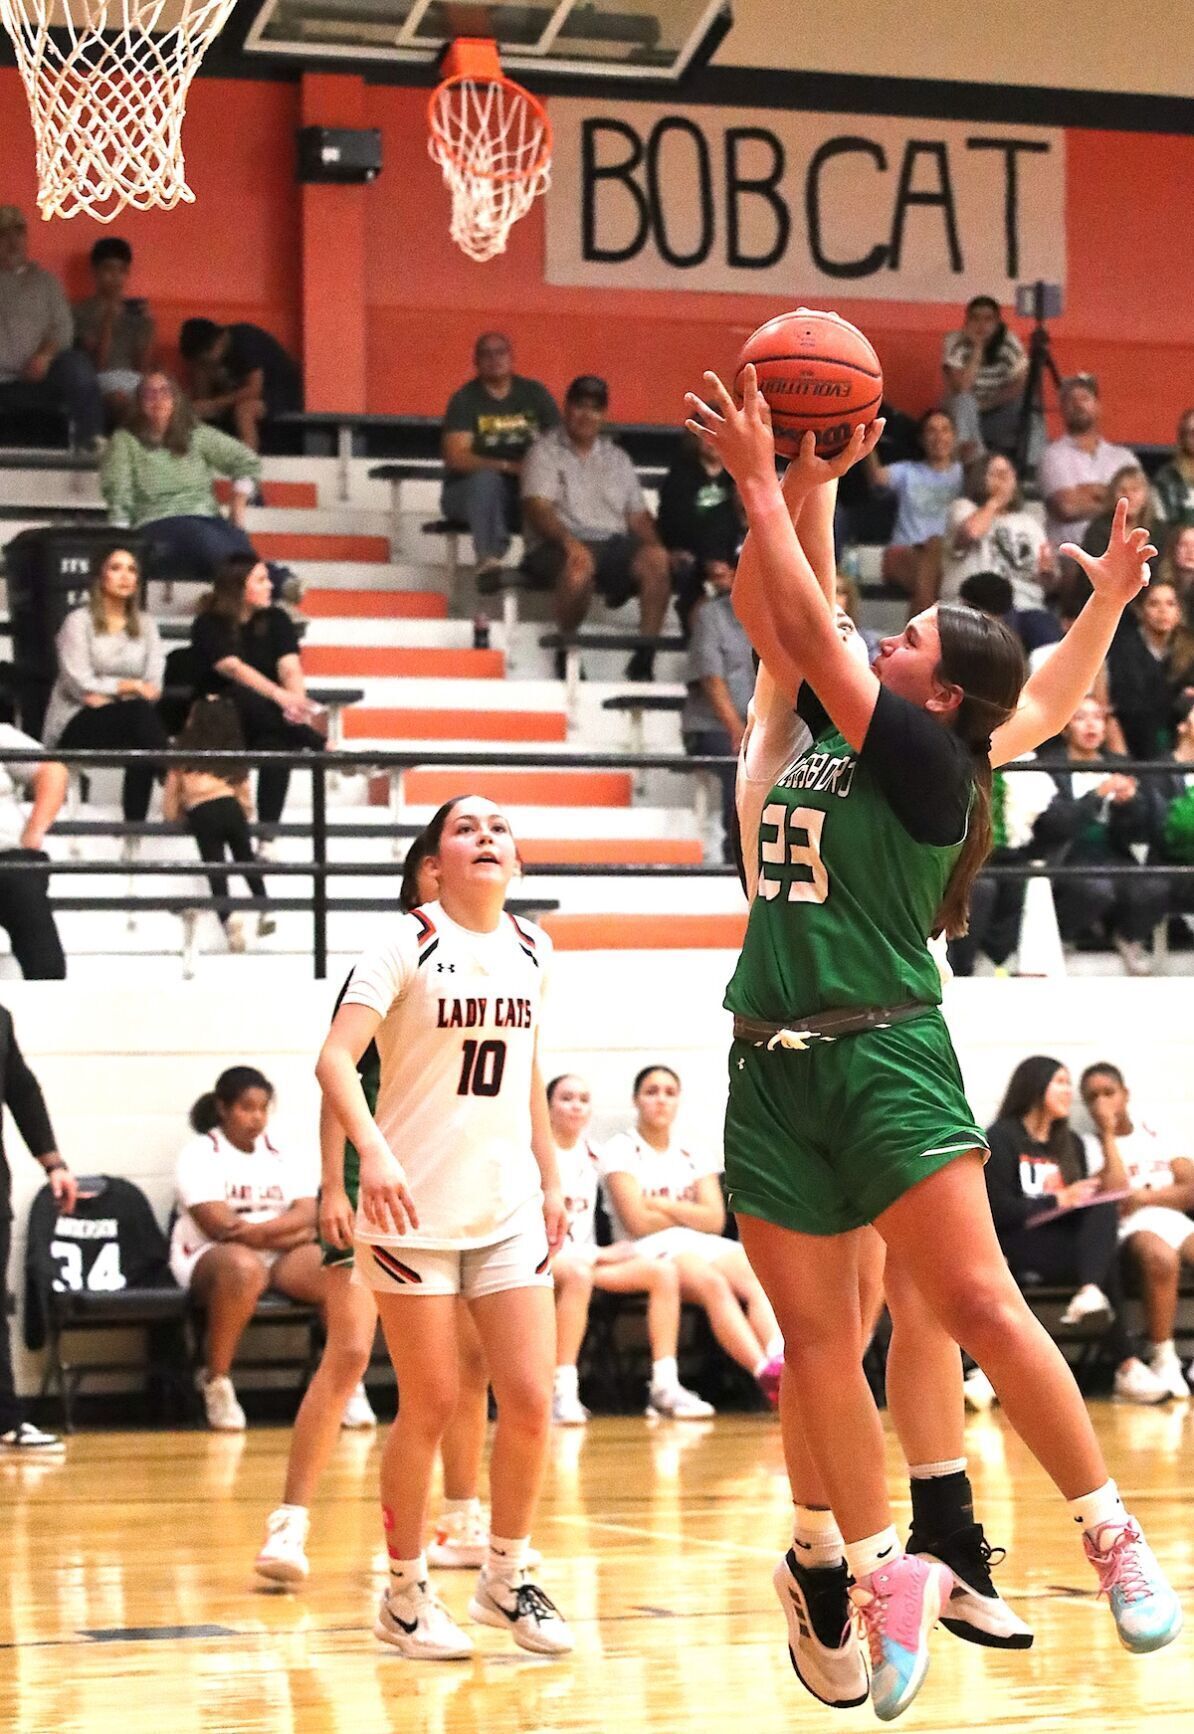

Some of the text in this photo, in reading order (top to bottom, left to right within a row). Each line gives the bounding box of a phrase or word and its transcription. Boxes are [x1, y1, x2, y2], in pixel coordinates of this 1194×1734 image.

[582, 116, 1051, 279] BOBCAT
[758, 804, 829, 904] 23
[437, 997, 532, 1029] LADY CATS
[457, 1039, 507, 1097] 10
[50, 1240, 127, 1293] 34
